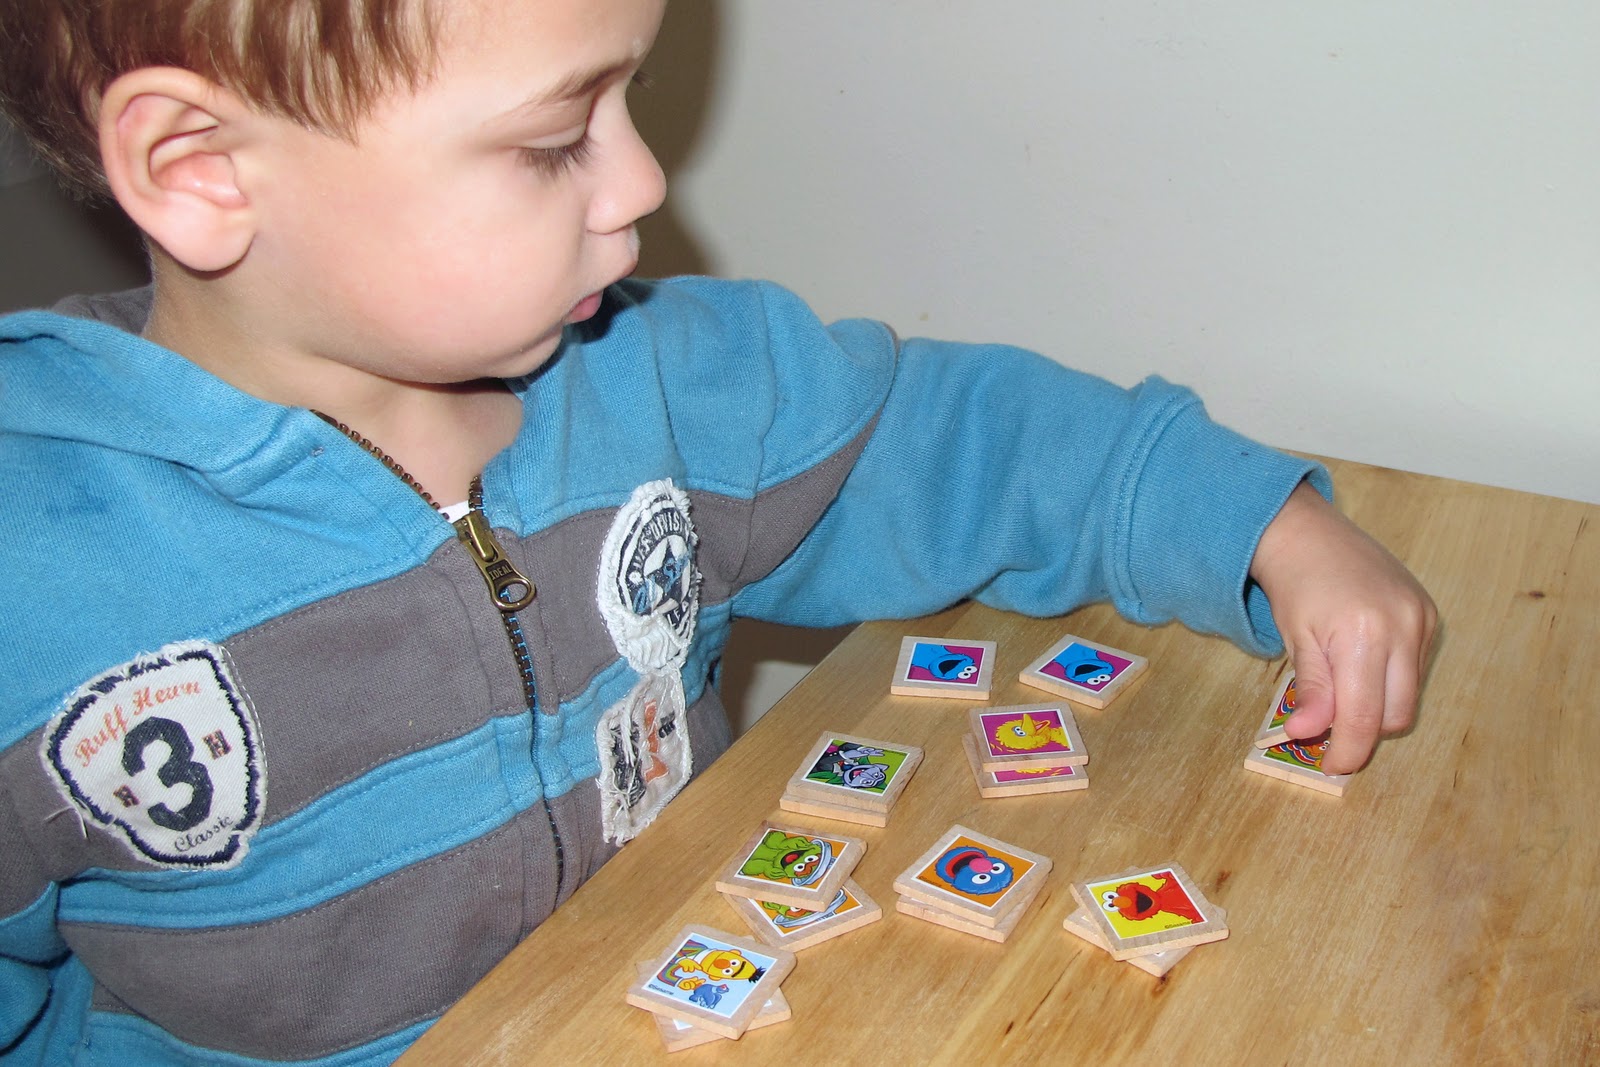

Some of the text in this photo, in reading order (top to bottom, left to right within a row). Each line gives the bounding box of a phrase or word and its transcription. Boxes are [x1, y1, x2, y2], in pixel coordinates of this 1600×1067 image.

[488, 564, 512, 580] IDEAL
[75, 704, 130, 768] Ruff
[121, 716, 215, 832] 3
[174, 816, 234, 852] Classic
